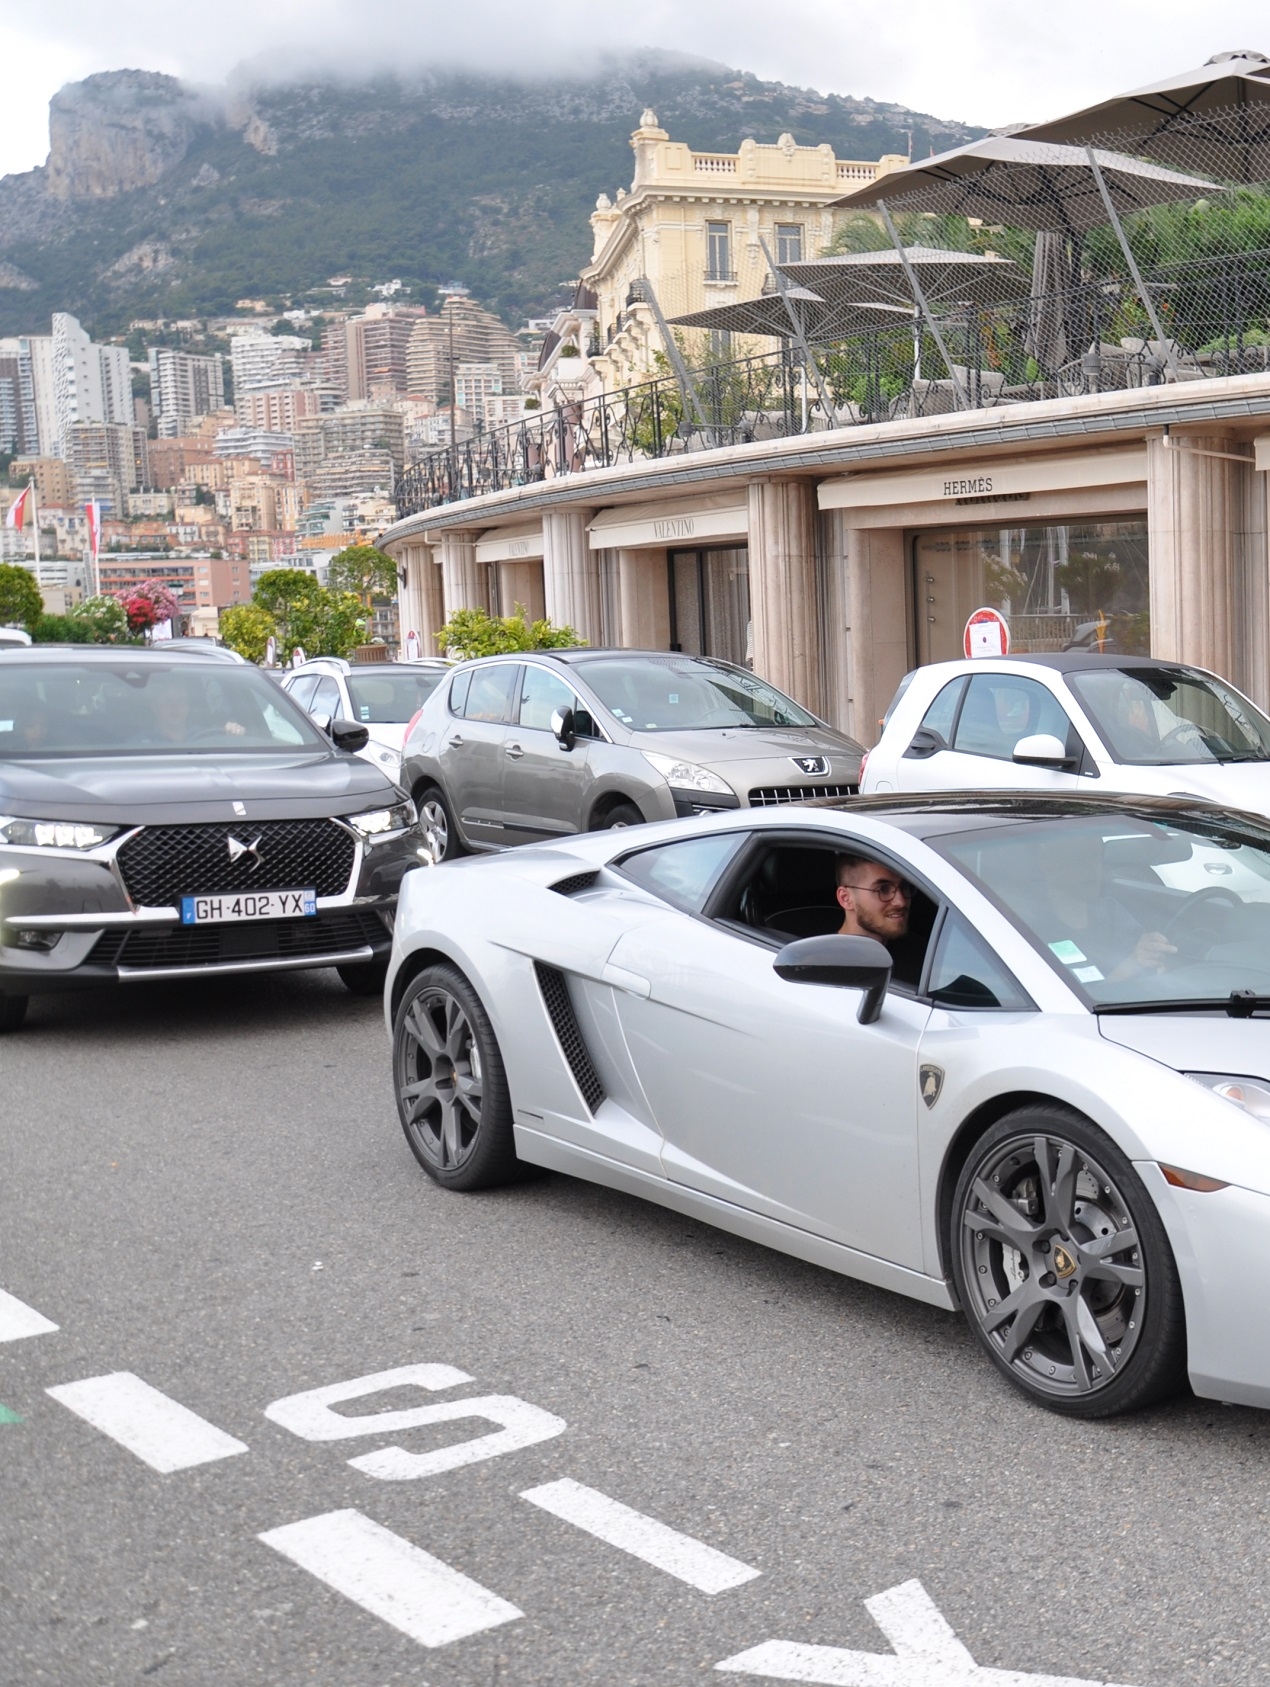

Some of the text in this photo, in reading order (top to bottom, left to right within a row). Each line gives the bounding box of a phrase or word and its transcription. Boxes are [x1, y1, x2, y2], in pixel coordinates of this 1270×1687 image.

[943, 476, 993, 496] HERMÈS
[653, 517, 695, 539] VALENTINO
[196, 893, 304, 920] GH-402-YX
